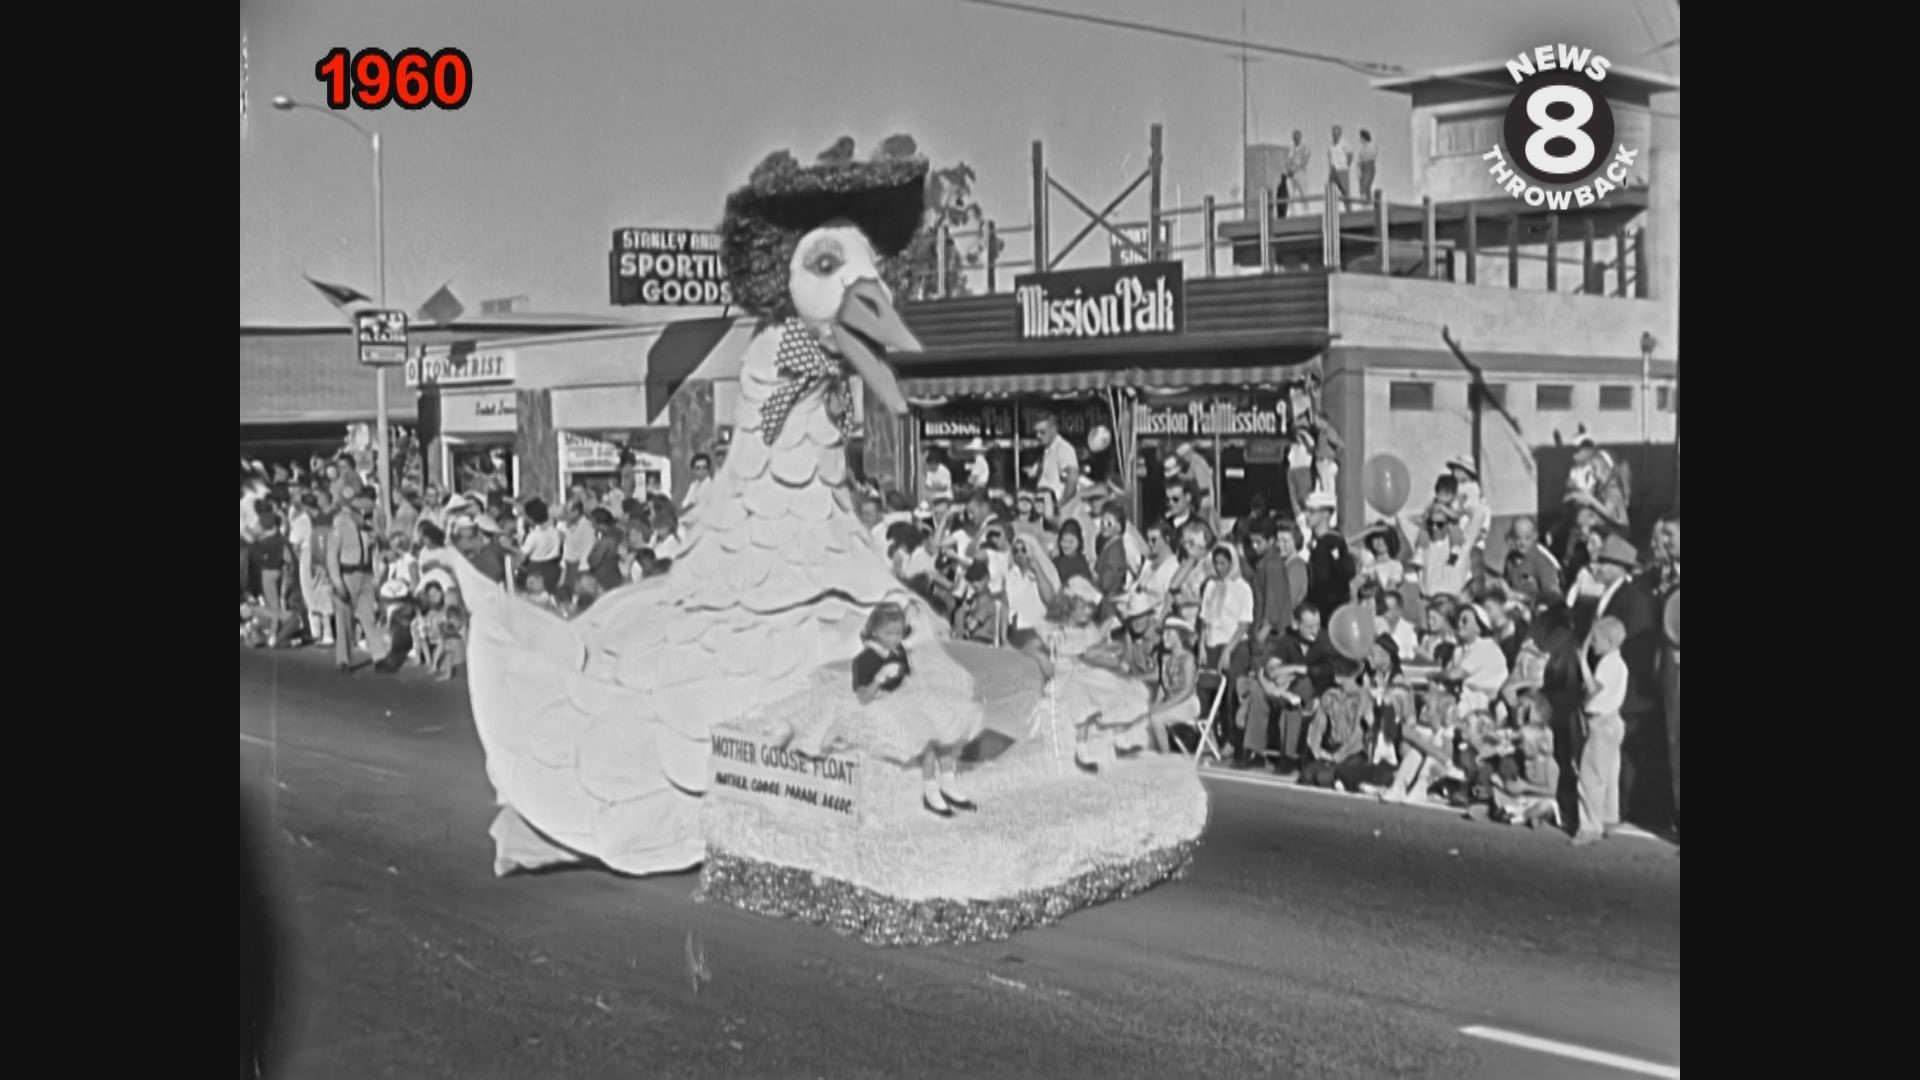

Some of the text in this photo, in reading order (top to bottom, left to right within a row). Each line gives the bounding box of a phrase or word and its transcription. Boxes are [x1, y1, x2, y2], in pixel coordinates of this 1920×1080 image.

[623, 230, 687, 249] STANLEY
[642, 279, 733, 303] GOODS
[1017, 275, 1174, 338] Mission Pak
[1136, 404, 1188, 434] Mission
[711, 734, 855, 785] MOTHER GOOSE FLOAT
